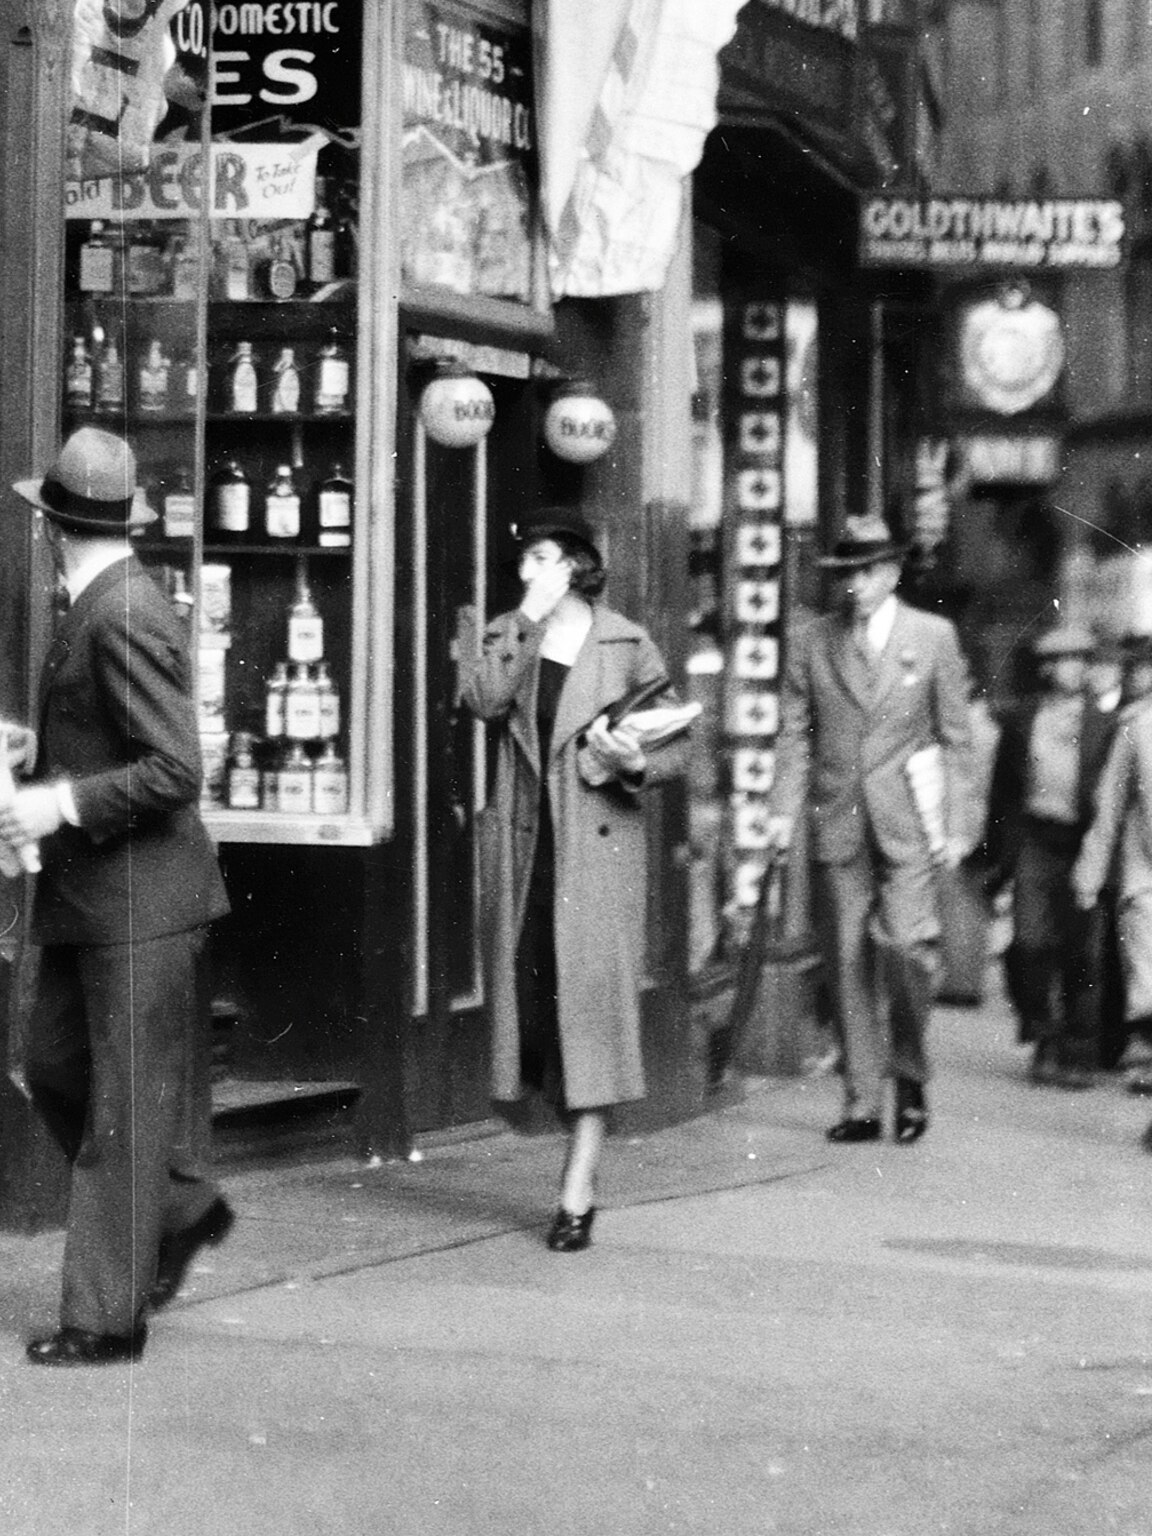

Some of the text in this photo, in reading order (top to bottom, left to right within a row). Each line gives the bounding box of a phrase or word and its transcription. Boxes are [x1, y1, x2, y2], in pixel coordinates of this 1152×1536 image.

[211, 1, 340, 35] OMESTIC
[436, 24, 505, 83] THE 55
[111, 151, 249, 211] BEER
